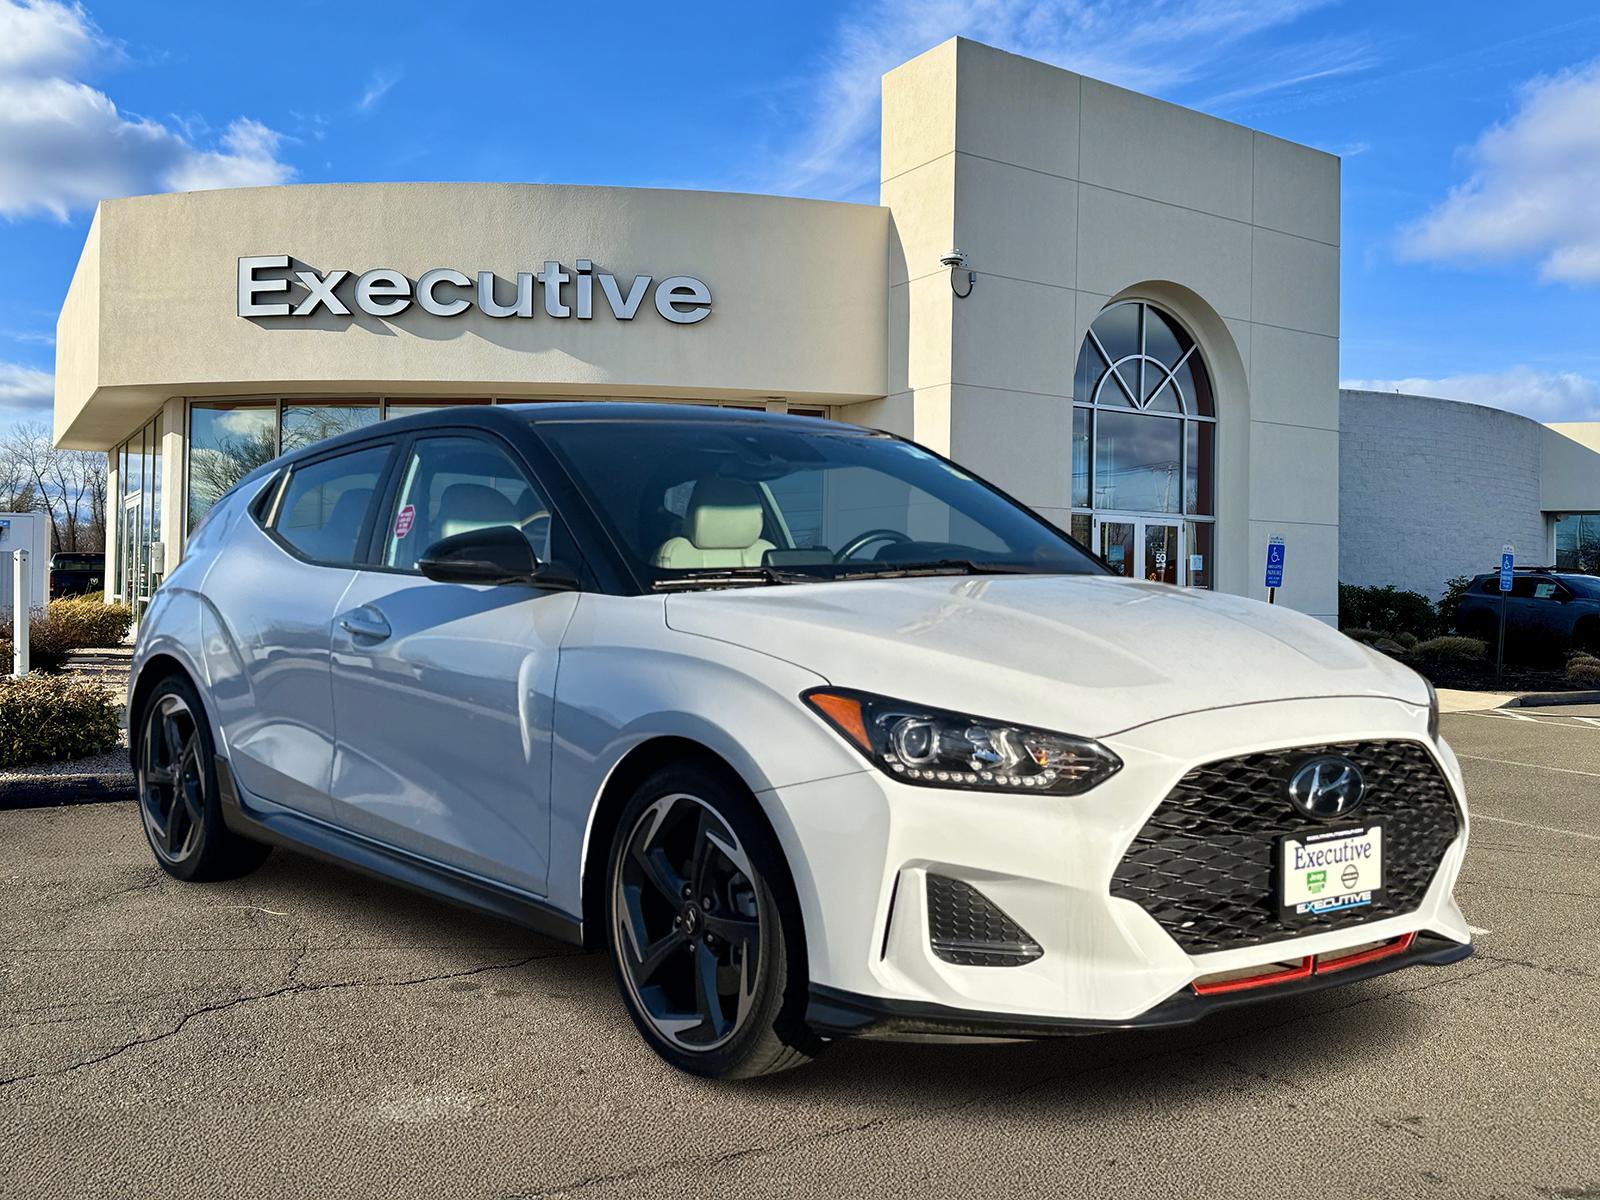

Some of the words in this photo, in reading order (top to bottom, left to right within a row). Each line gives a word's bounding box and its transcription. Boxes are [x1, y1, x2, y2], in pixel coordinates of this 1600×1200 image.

[237, 254, 712, 324] Executive
[1294, 839, 1372, 870] Executive
[1296, 891, 1372, 914] EXECUTIVE
